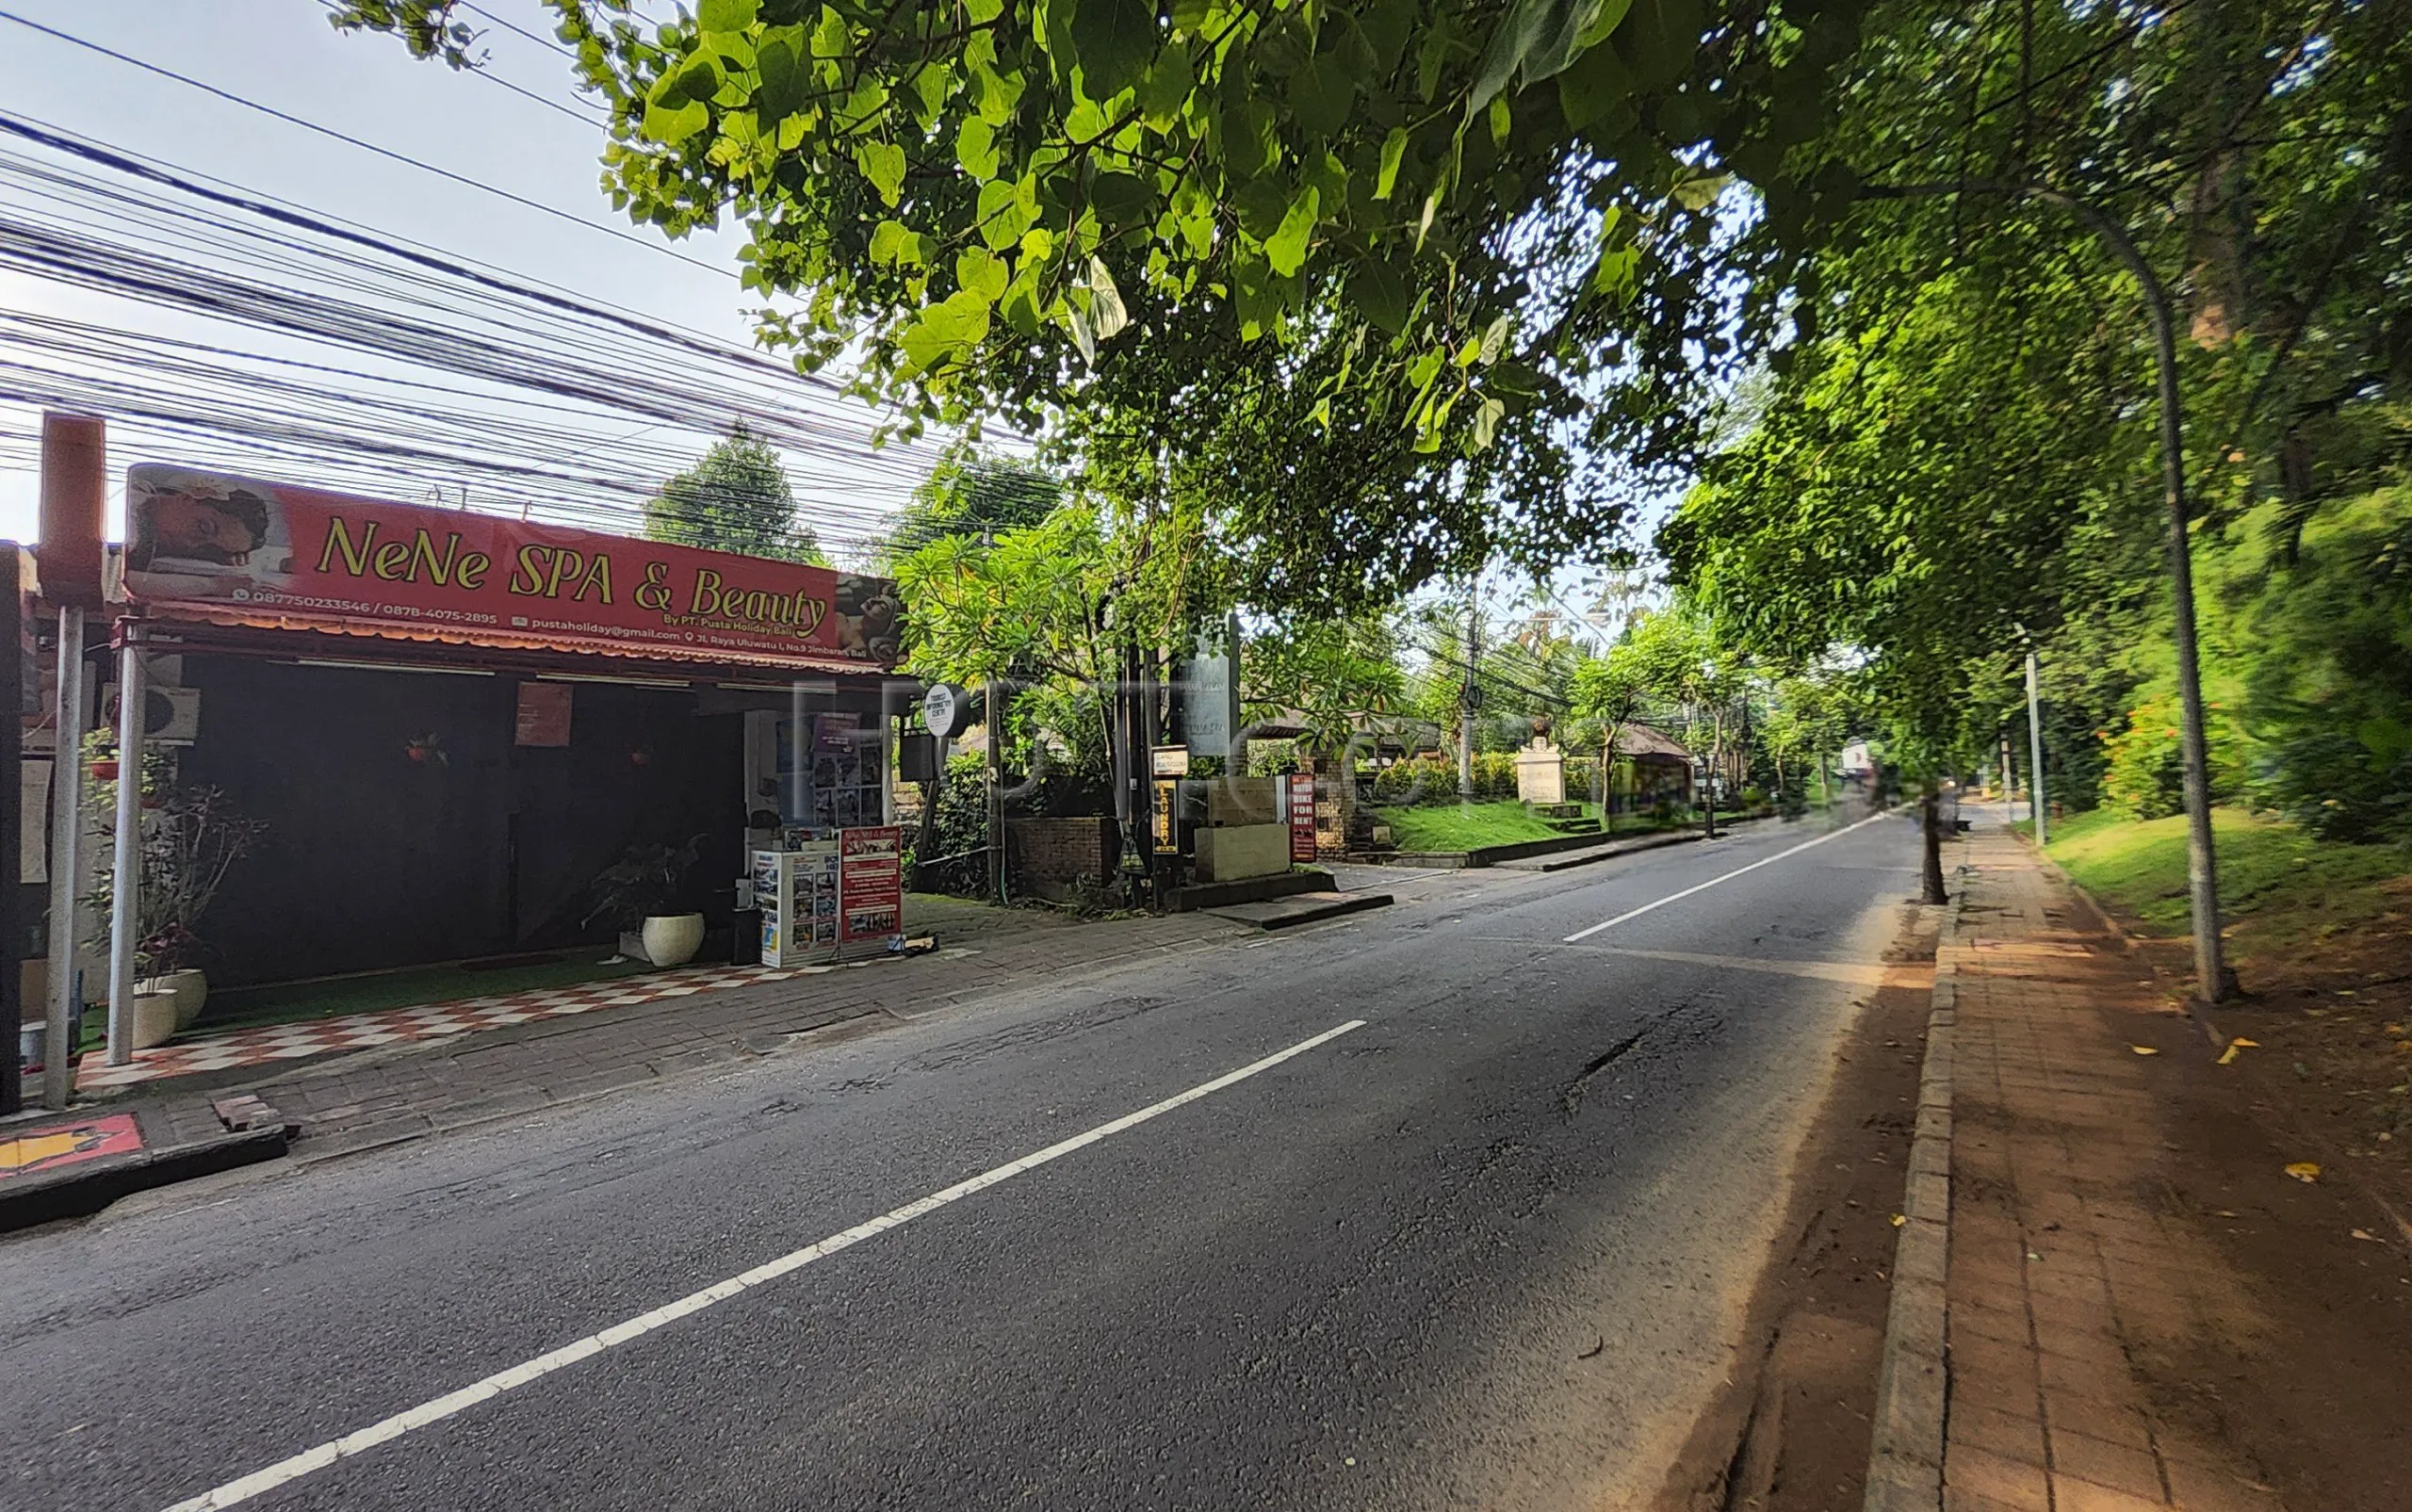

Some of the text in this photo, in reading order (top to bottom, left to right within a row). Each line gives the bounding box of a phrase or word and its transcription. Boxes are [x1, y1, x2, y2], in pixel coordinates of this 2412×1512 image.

[316, 516, 825, 638] NeNe SPA & Beauty
[253, 592, 369, 611] 087750233546
[383, 604, 497, 624] 0878-4075-2895
[532, 618, 680, 641] pustaholiday@gmail.com
[664, 615, 792, 636] By PT. Pusta Holiday Bali
[710, 637, 734, 646] Raya
[737, 639, 776, 650] Uluwatu
[851, 648, 867, 658] Bali
[1293, 794, 1312, 804] BIKE
[1160, 786, 1170, 845] LAUNDRY
[1294, 805, 1312, 815] FOR
[1294, 816, 1312, 825] RENT
